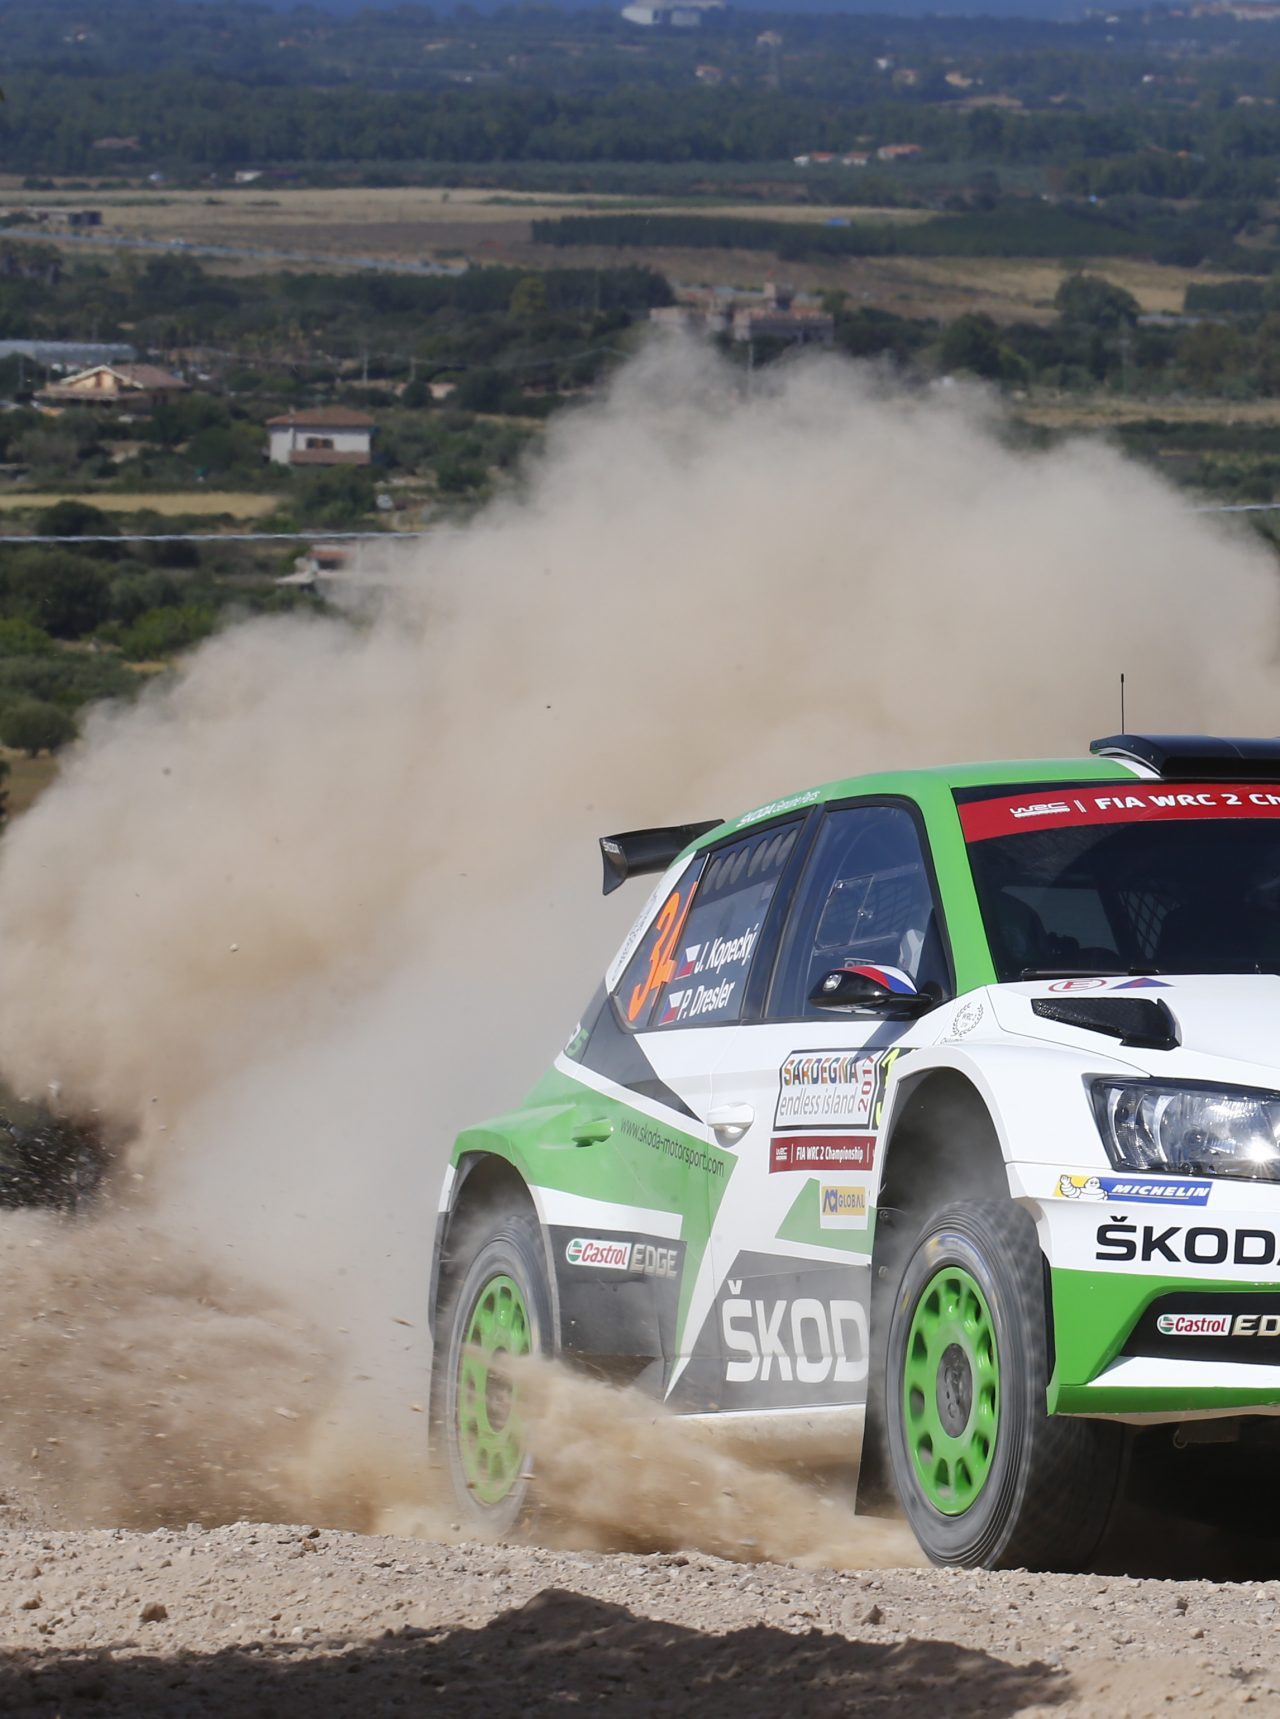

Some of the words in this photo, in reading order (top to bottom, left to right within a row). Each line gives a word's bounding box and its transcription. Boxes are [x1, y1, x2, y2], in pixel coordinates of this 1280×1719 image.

[1094, 794, 1147, 811] FIA
[1148, 793, 1217, 807] WRC
[1220, 793, 1243, 806] 2
[627, 880, 699, 1021] 34
[693, 941, 711, 975] J.
[704, 922, 760, 975] Kopecký
[676, 987, 693, 1021] P.
[688, 977, 736, 1018] Dresler
[783, 1056, 860, 1086] SARDEGNA
[857, 1055, 876, 1113] 2017
[779, 1087, 822, 1117] endless
[821, 1085, 859, 1115] island
[619, 1117, 725, 1178] www.skoda-motorsport.com
[796, 1146, 806, 1161] FIA
[806, 1146, 820, 1161] WRC
[819, 1146, 825, 1161] 2
[825, 1145, 864, 1164] Championship
[838, 1193, 866, 1209] GLOBAL
[1111, 1182, 1211, 1199] MICHELIN
[581, 1242, 628, 1266] Castrol
[628, 1243, 678, 1280] EDGE
[721, 1279, 870, 1384] ŠKOD
[1174, 1315, 1228, 1334] Castrol
